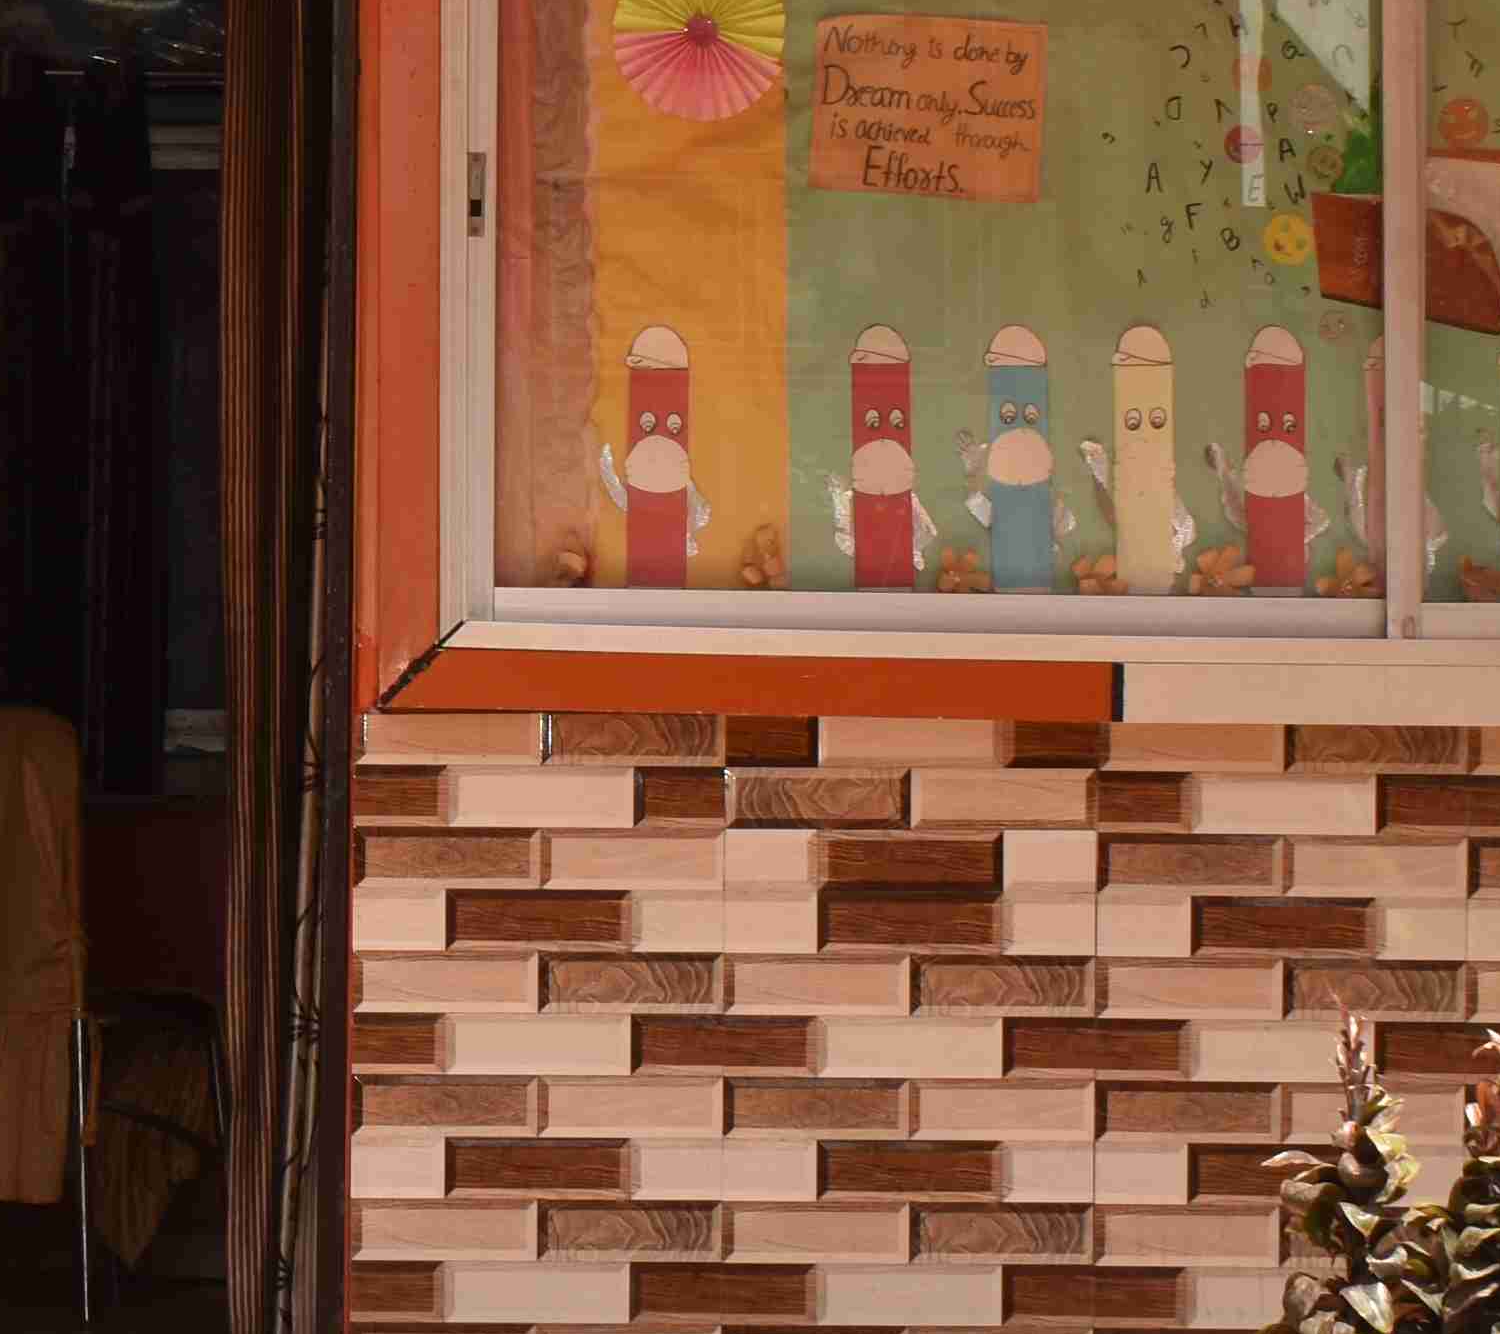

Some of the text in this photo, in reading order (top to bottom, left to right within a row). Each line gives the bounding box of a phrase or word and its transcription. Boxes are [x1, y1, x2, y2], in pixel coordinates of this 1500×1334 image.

[823, 24, 1030, 75] Nothing is done by
[822, 63, 911, 110] Dream
[830, 113, 849, 139] is
[855, 118, 931, 145] achieved
